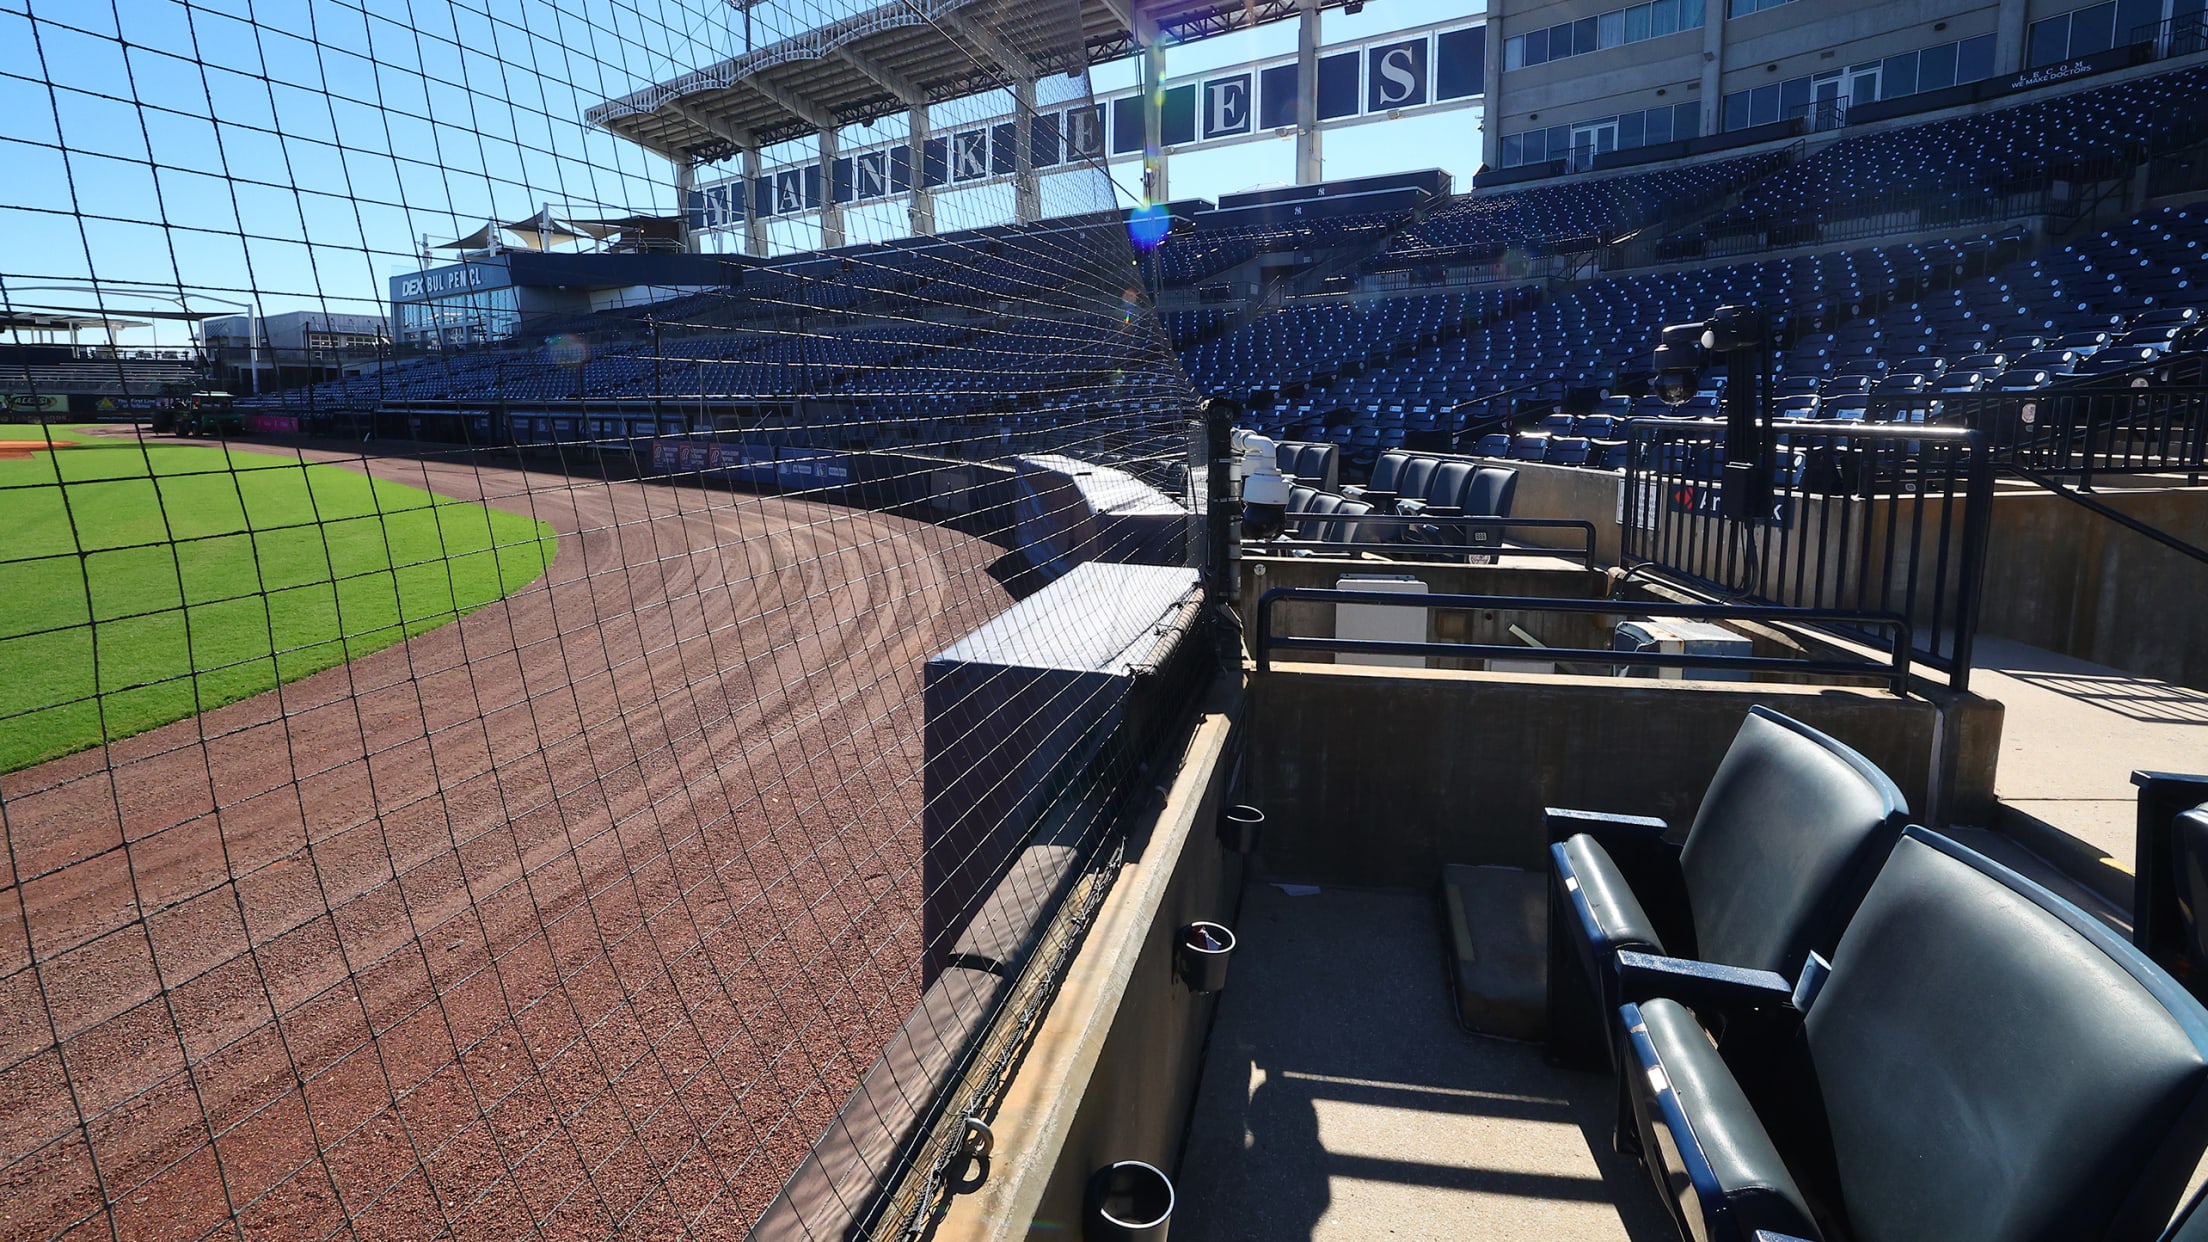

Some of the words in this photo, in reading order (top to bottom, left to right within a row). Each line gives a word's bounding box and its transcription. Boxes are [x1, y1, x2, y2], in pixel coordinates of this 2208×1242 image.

[2011, 80, 2024, 89] WE
[2025, 75, 2049, 85] MAKE
[2050, 64, 2092, 80] DOCTORS
[402, 278, 424, 297] DEX
